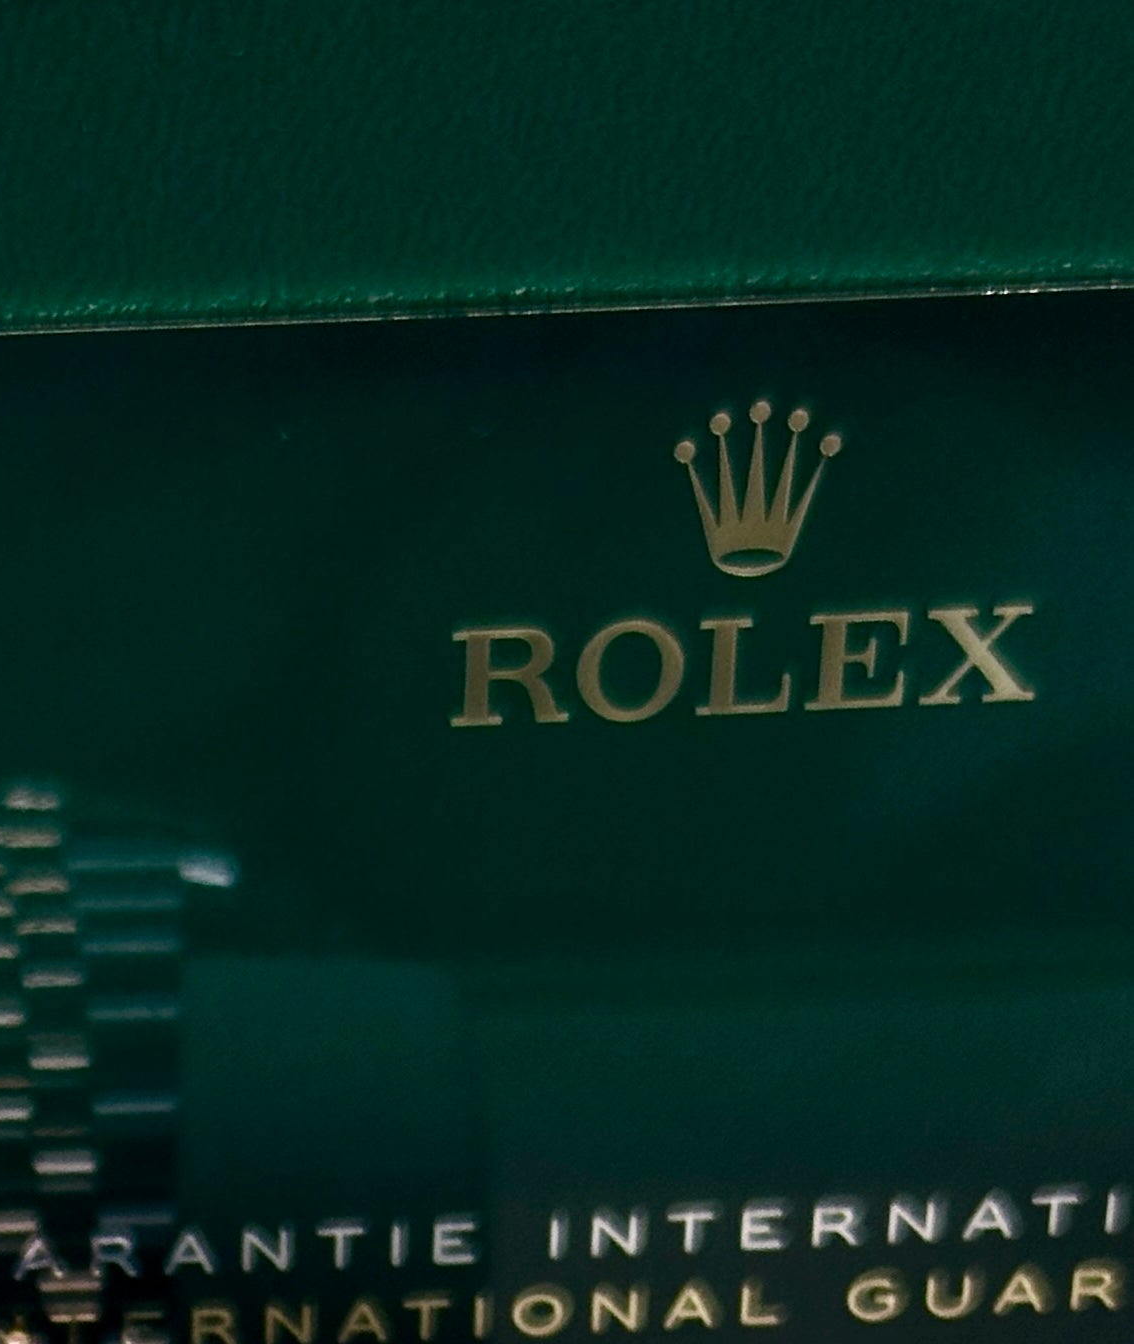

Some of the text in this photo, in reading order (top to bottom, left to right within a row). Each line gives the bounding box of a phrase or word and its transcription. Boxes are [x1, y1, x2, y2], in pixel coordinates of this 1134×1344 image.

[450, 605, 1036, 728] ROLEX
[549, 1192, 1119, 1260] INTERNATI
[847, 1267, 1120, 1323] GUAR
